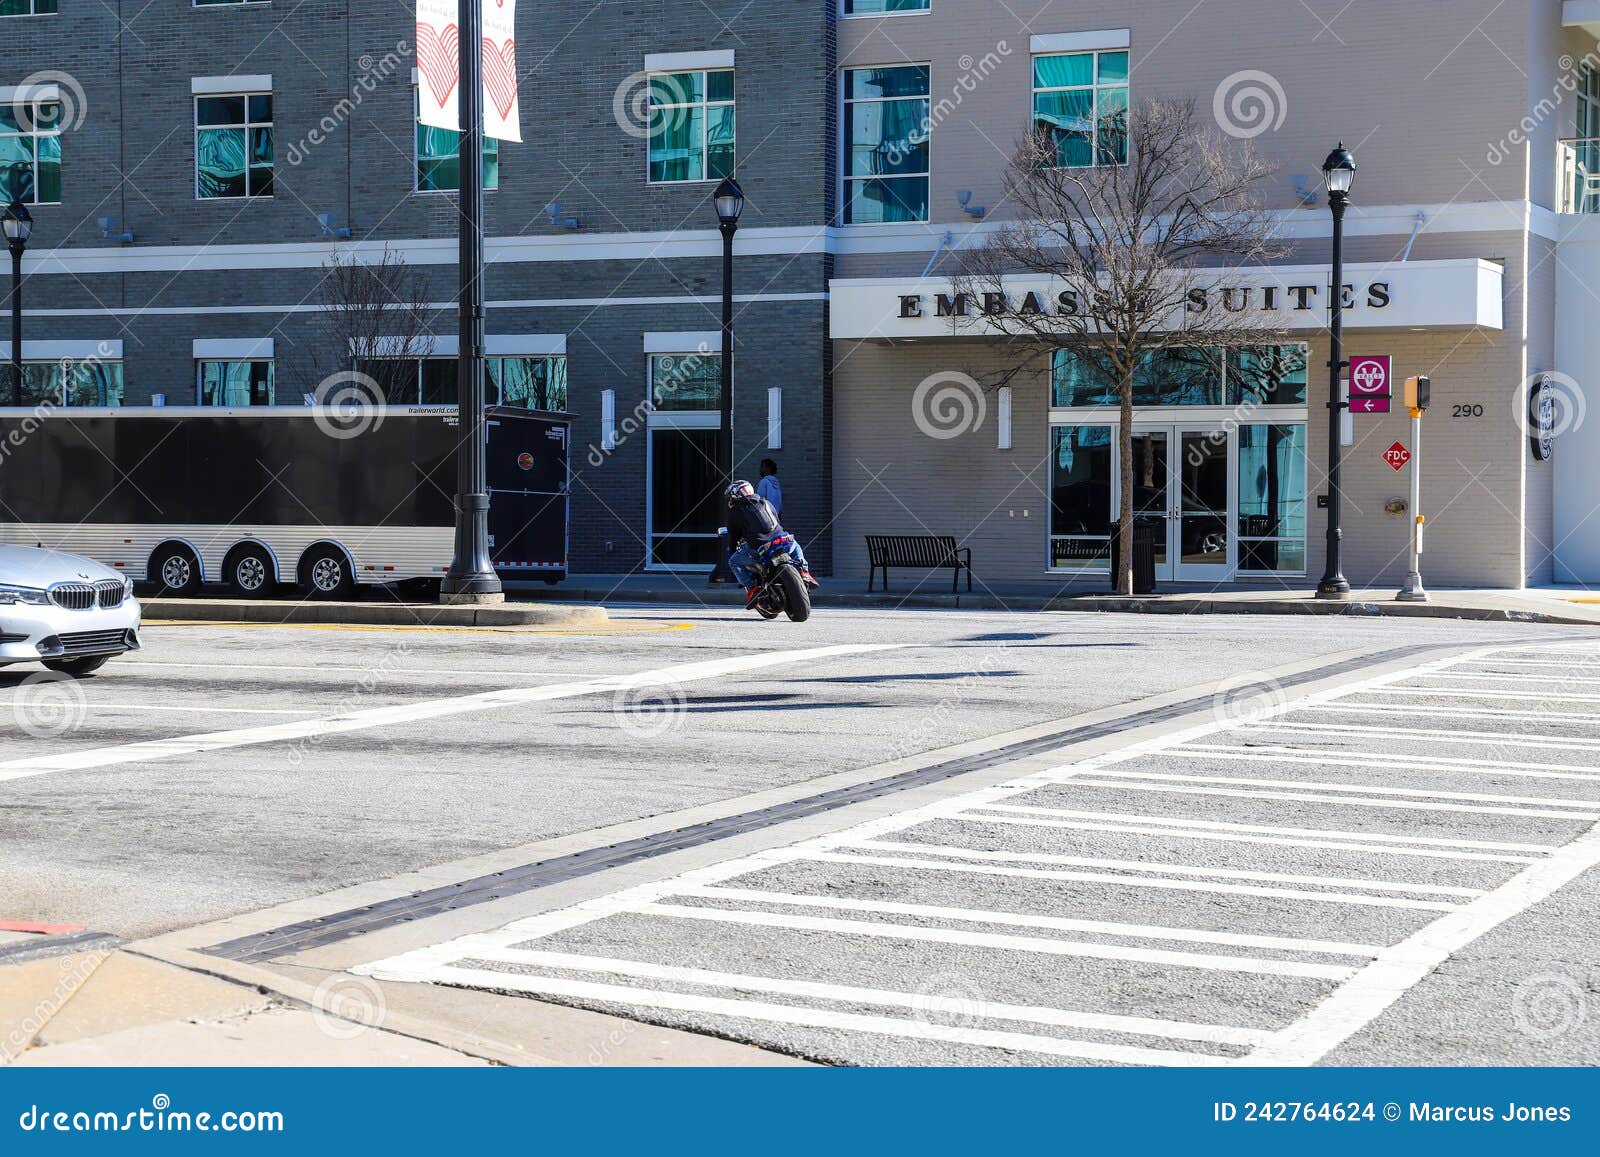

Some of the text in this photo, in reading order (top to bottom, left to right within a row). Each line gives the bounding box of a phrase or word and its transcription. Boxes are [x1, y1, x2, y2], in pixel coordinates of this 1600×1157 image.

[1186, 282, 1391, 312] SUITES
[1452, 404, 1484, 418] 290
[1387, 450, 1408, 461] FDC
